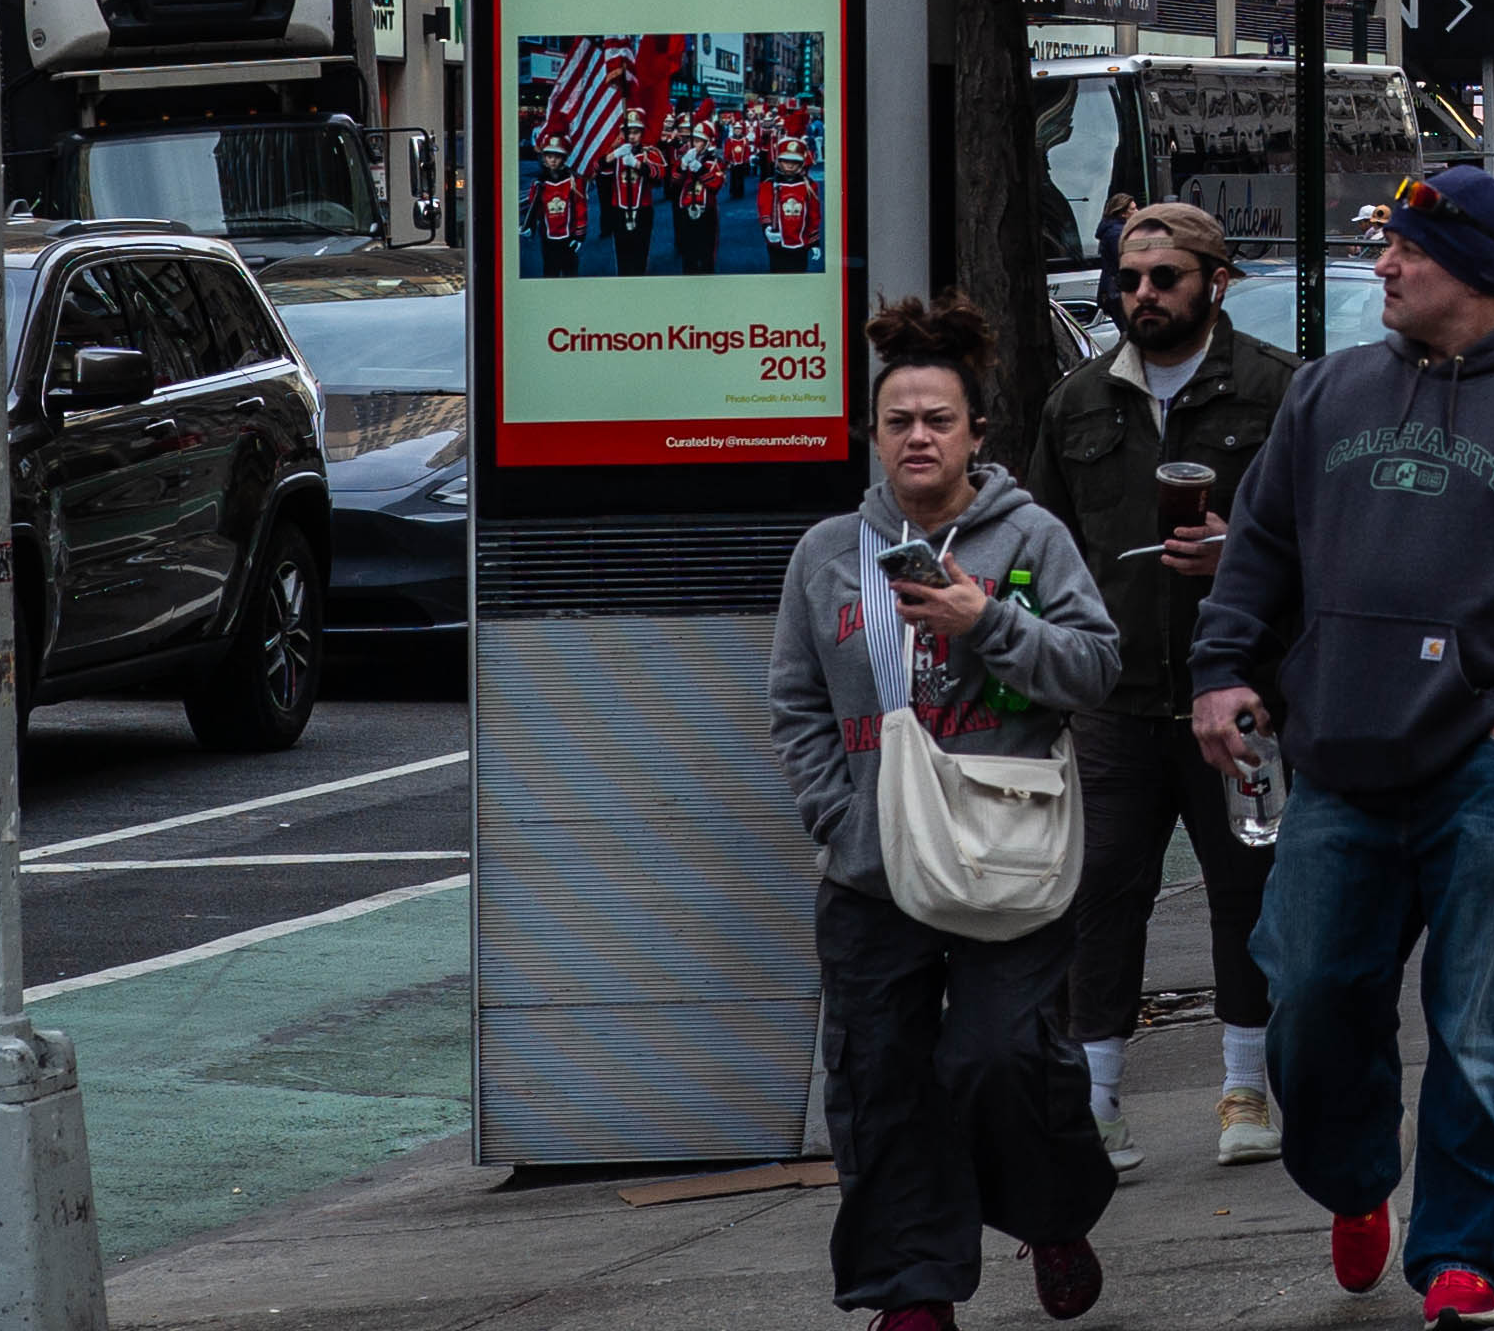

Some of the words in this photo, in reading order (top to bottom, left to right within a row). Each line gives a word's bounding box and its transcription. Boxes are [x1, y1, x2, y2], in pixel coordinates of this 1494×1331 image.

[1218, 186, 1283, 239] Academy
[547, 326, 664, 353] Crimson
[667, 325, 744, 354] Kings
[748, 323, 827, 351] Band,
[760, 356, 826, 381] 2013
[666, 436, 710, 449] Curated
[711, 436, 724, 449] by
[726, 434, 827, 447] @museumofcityny
